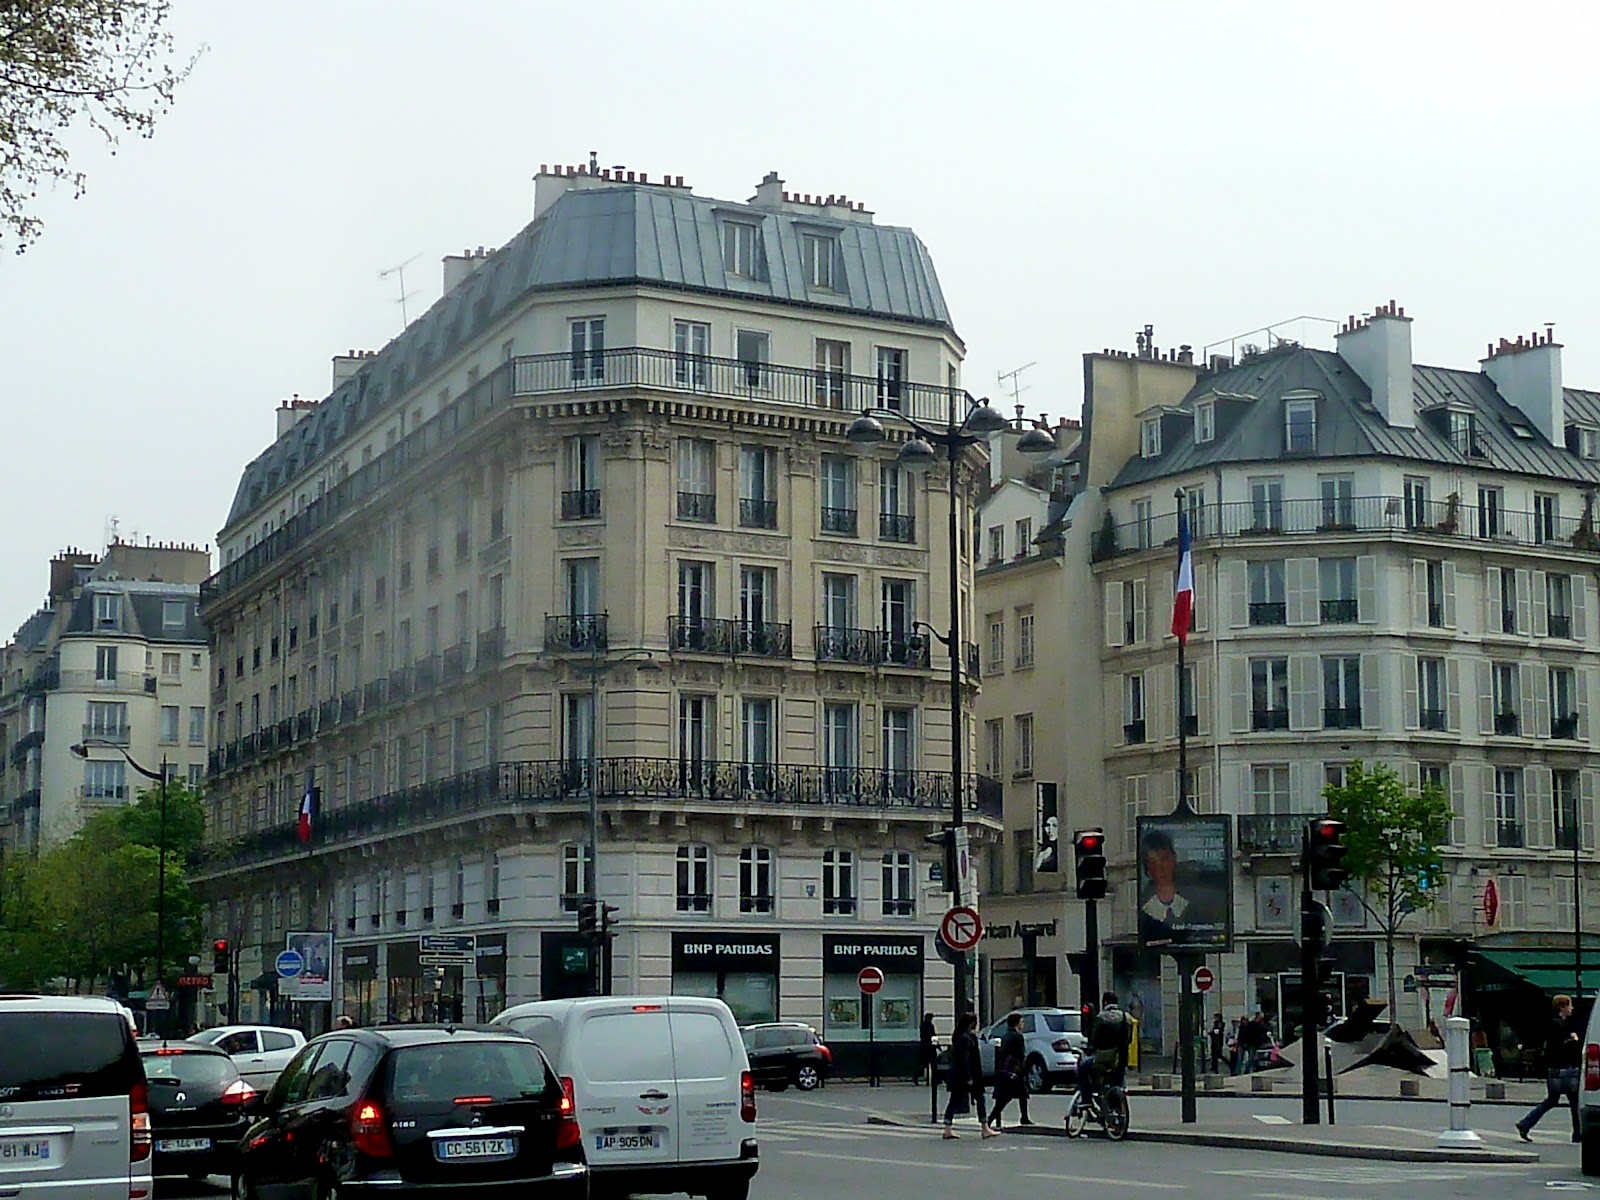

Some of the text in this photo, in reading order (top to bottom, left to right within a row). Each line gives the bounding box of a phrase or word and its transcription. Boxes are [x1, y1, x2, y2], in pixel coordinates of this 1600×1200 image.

[683, 943, 773, 955] BNP PARIBAS
[833, 945, 918, 956] BNP PARIBAS
